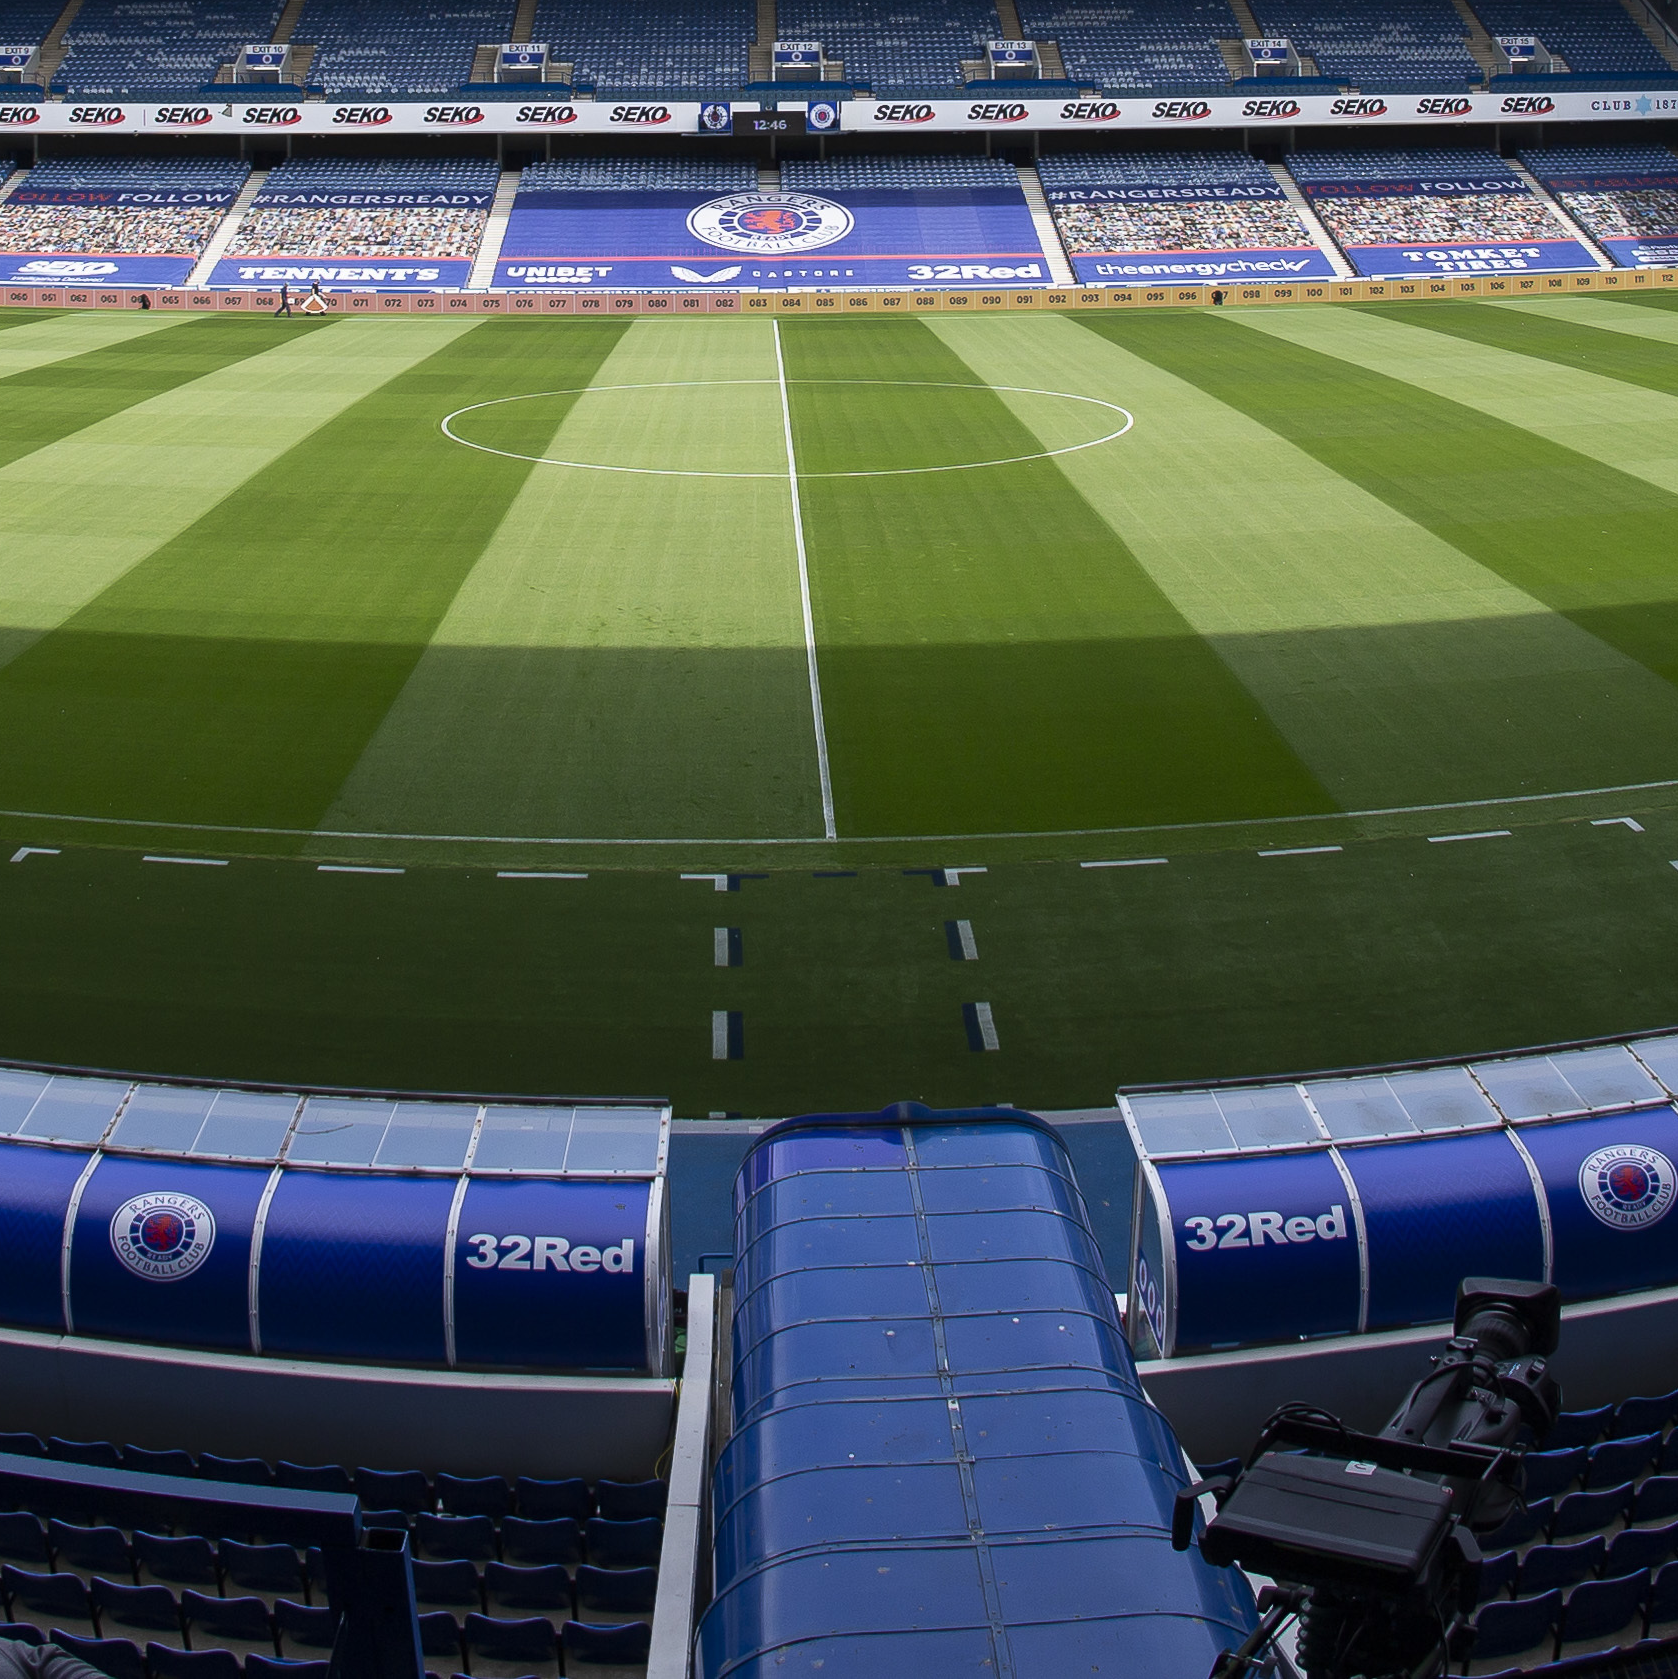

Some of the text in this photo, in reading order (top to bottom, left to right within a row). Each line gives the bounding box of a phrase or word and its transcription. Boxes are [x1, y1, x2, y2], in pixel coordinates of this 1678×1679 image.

[252, 45, 272, 54] EXIT
[508, 44, 530, 53] EXIT
[780, 42, 801, 51] EXIT
[994, 41, 1016, 50] EXIT
[1251, 39, 1271, 48] EXIT
[1500, 37, 1519, 45] EXIT
[5, 47, 23, 55] EXIT
[873, 104, 933, 122] SEKO
[967, 103, 1027, 121] SEKO
[1060, 102, 1119, 120] SEKO
[1151, 101, 1210, 119] SEKO
[1242, 100, 1299, 118] SEKO
[1329, 98, 1386, 116] SEKO
[1416, 98, 1471, 115] SEKO
[1500, 97, 1554, 114] SEKO
[1591, 100, 1632, 112] CLUB
[68, 107, 124, 124] SEKO
[153, 107, 210, 124] SEKO
[242, 107, 300, 124] SEKO
[332, 107, 390, 124] SEKO
[423, 107, 482, 124] SEKO
[515, 106, 575, 123] SEKO
[609, 106, 669, 123] SEKO
[752, 119, 788, 132] 12:46
[1420, 177, 1526, 191] FOLLOW
[117, 192, 233, 204] FOLLOW
[252, 193, 490, 206] #RANGERSREADY
[711, 192, 830, 212] RANGERS
[1047, 185, 1282, 202] #RANGERSREADY
[700, 225, 795, 251] FOOTBALL
[506, 266, 613, 279] UNIBET
[906, 263, 1042, 280] 32Red
[1440, 259, 1527, 271] TIRES
[239, 266, 440, 282] TENNENT'S
[515, 298, 902, 310] 076 078 080 083 085 087
[1587, 1148, 1659, 1173] RANGERS
[129, 1196, 206, 1220] RANGERS
[1591, 1182, 1672, 1223] FOOTBALL CLUB
[1184, 1204, 1348, 1252] 32Red
[118, 1235, 205, 1275] FOOTBALL CLUB
[465, 1233, 635, 1274] 32Red
